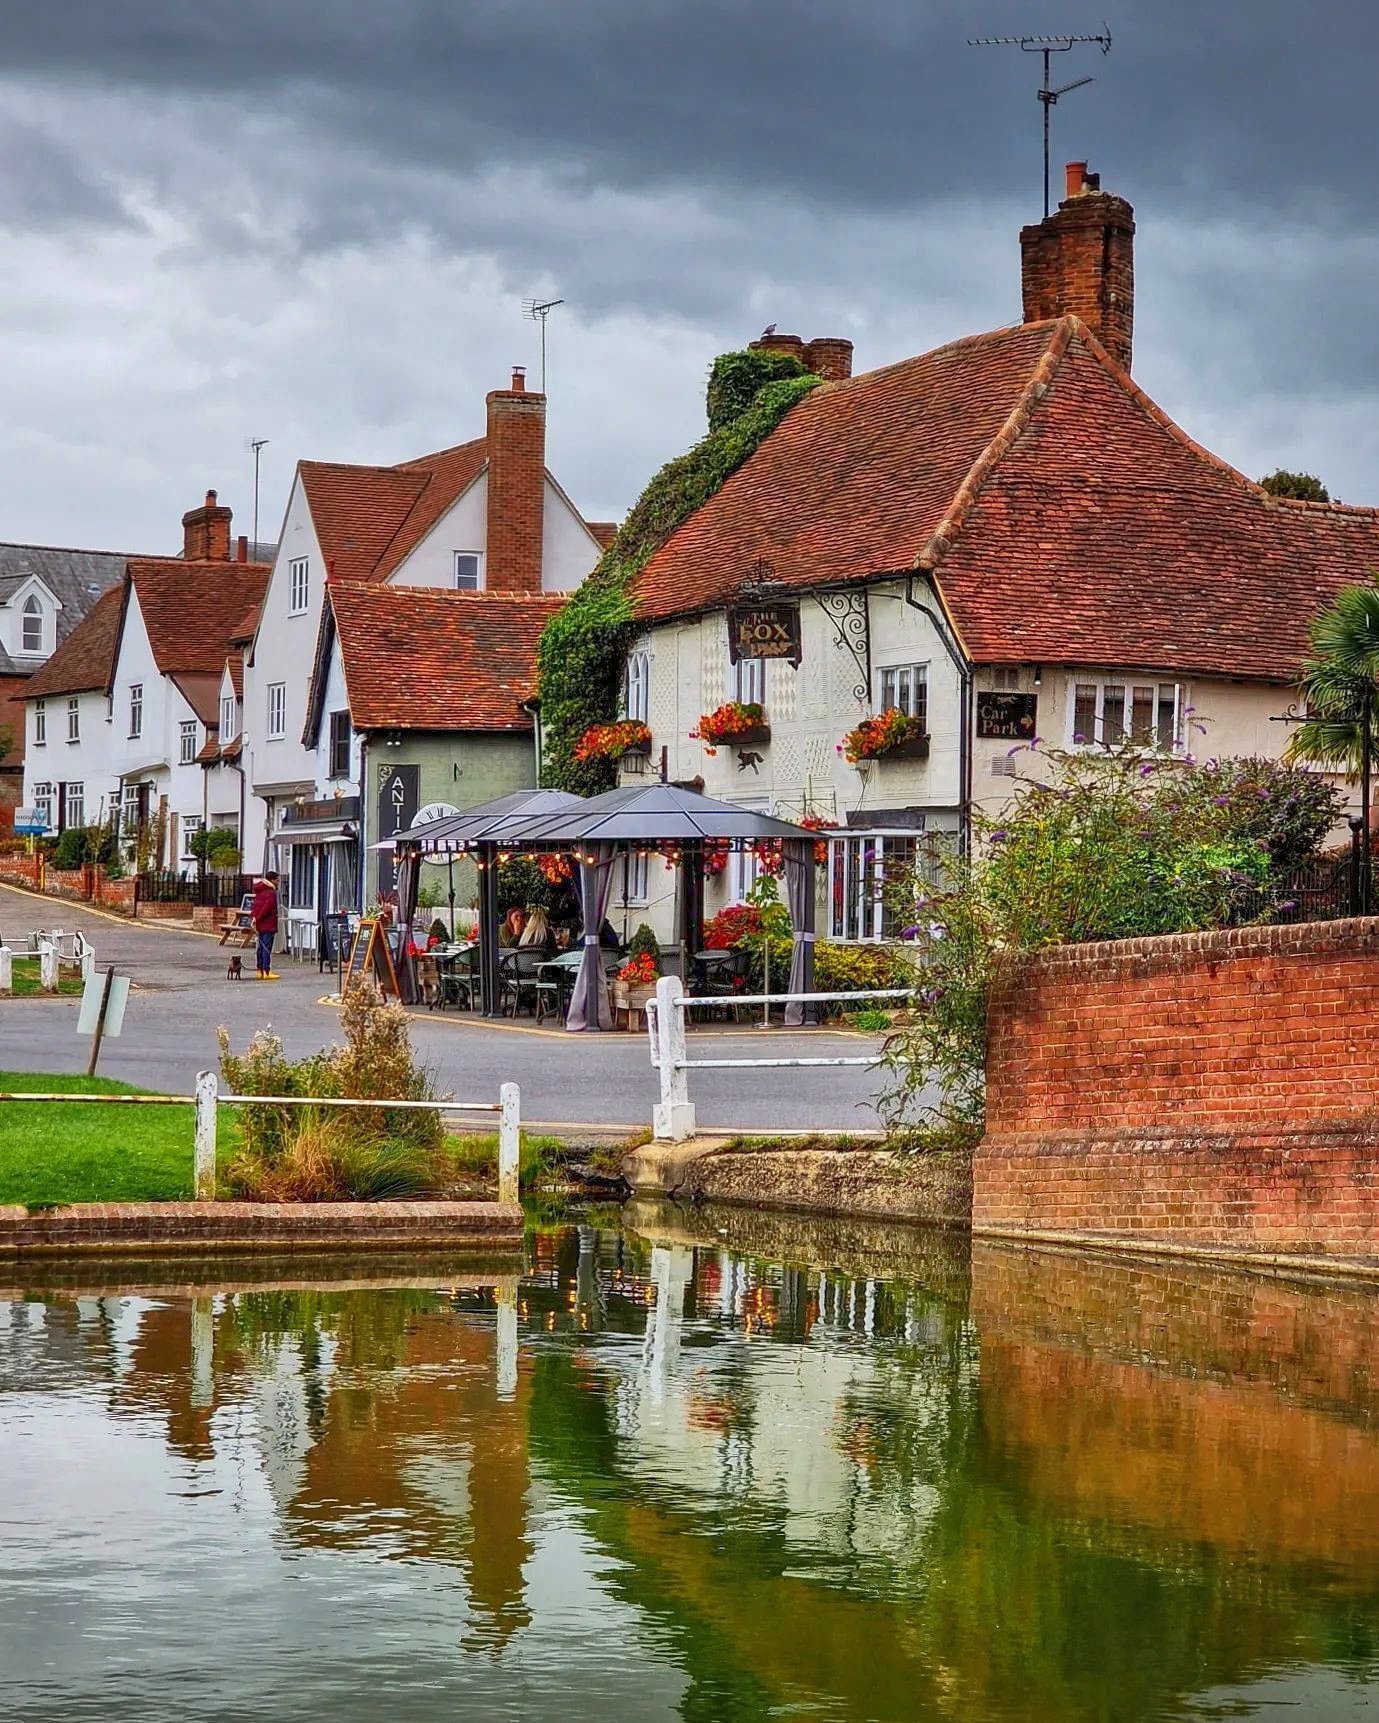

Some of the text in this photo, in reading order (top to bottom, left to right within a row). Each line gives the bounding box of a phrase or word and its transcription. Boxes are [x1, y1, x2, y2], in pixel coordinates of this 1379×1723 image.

[740, 623, 790, 640] FOX
[981, 705, 1008, 720] Car
[982, 720, 1018, 735] Park
